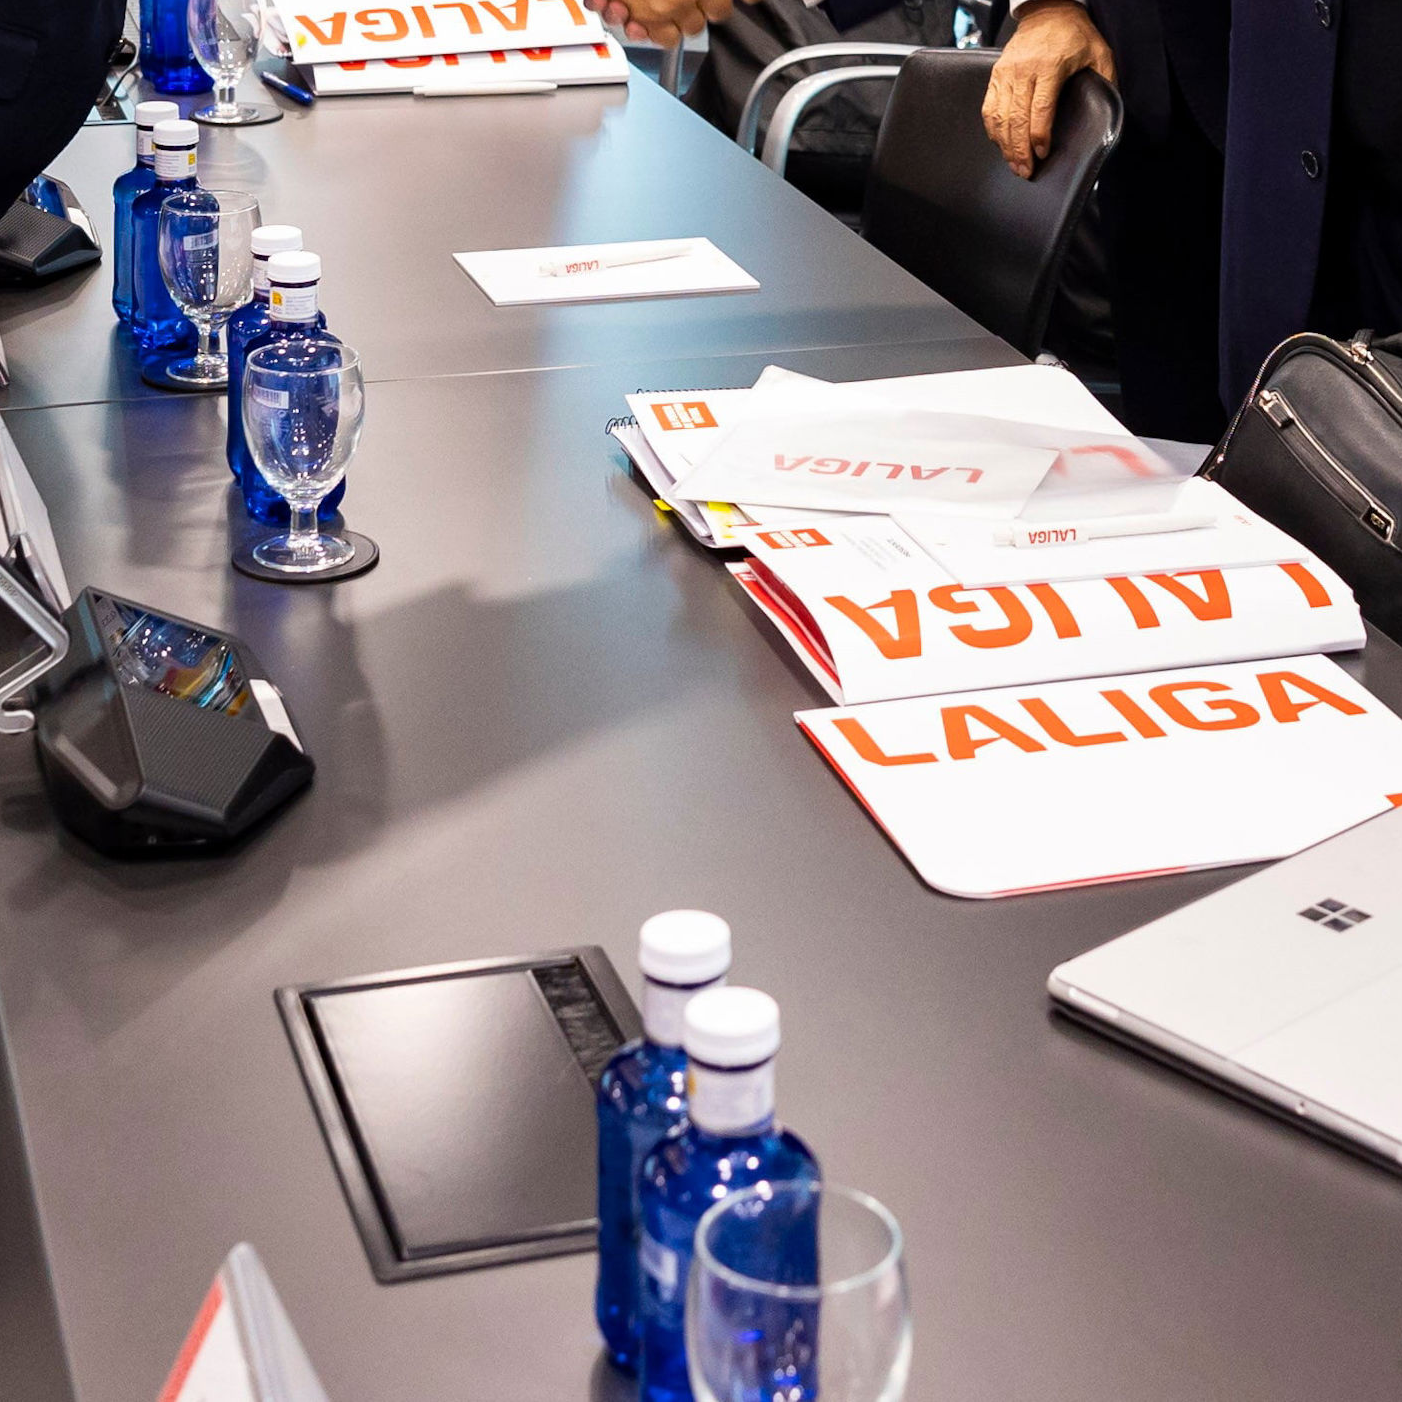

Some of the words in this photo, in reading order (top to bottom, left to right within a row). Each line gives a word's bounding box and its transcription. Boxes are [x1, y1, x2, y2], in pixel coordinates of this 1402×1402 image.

[565, 260, 599, 274] LALIGA
[774, 454, 985, 484] LALIGA
[1028, 528, 1076, 544] LALIGA
[830, 670, 1369, 767] LALIGA
